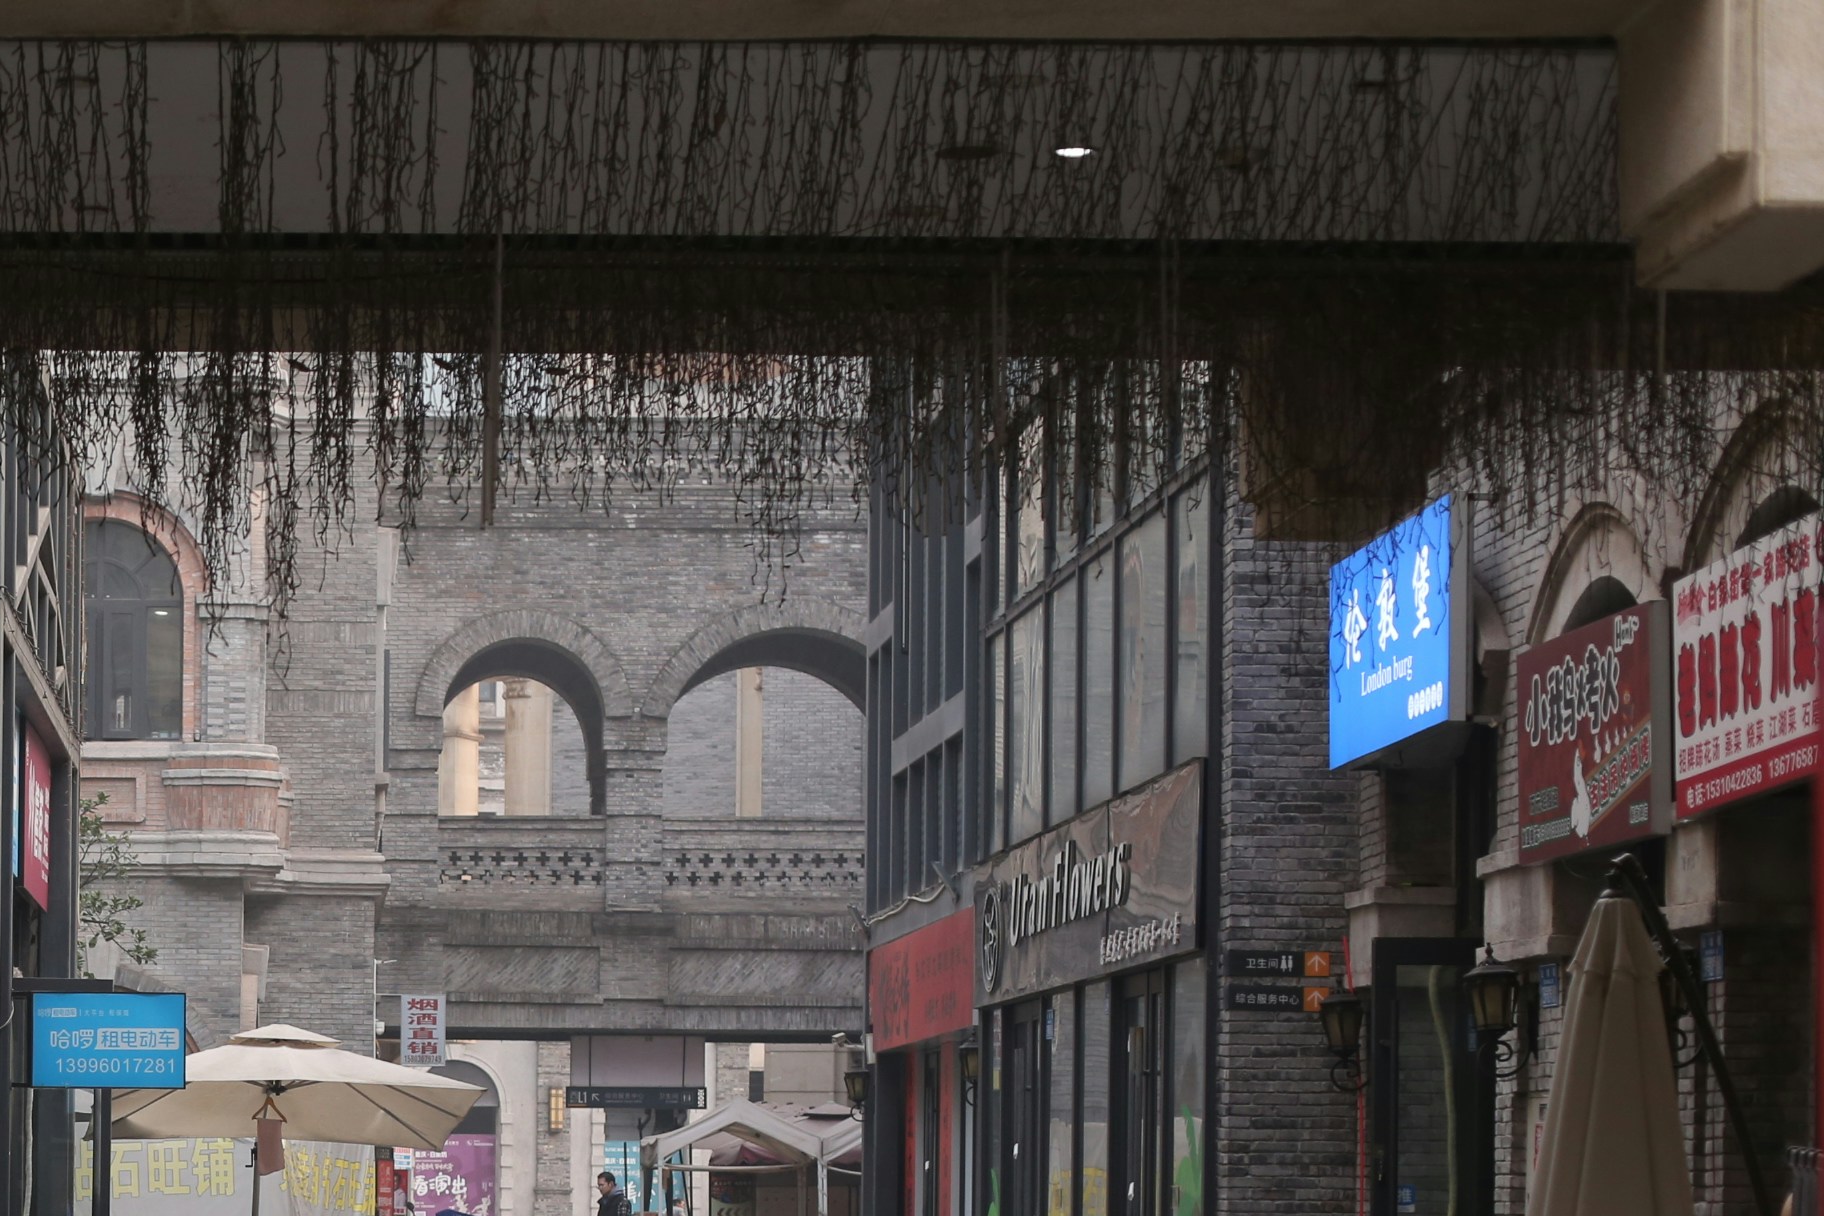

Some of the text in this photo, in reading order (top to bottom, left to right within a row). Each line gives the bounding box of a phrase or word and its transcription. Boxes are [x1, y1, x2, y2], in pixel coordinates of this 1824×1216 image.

[1361, 655, 1413, 696] London burg
[1246, 958, 1279, 969] 卫生间
[1236, 993, 1299, 1005] 综合服务中心
[407, 998, 439, 1054] 烟酒直销
[55, 1058, 175, 1073] 13996017281
